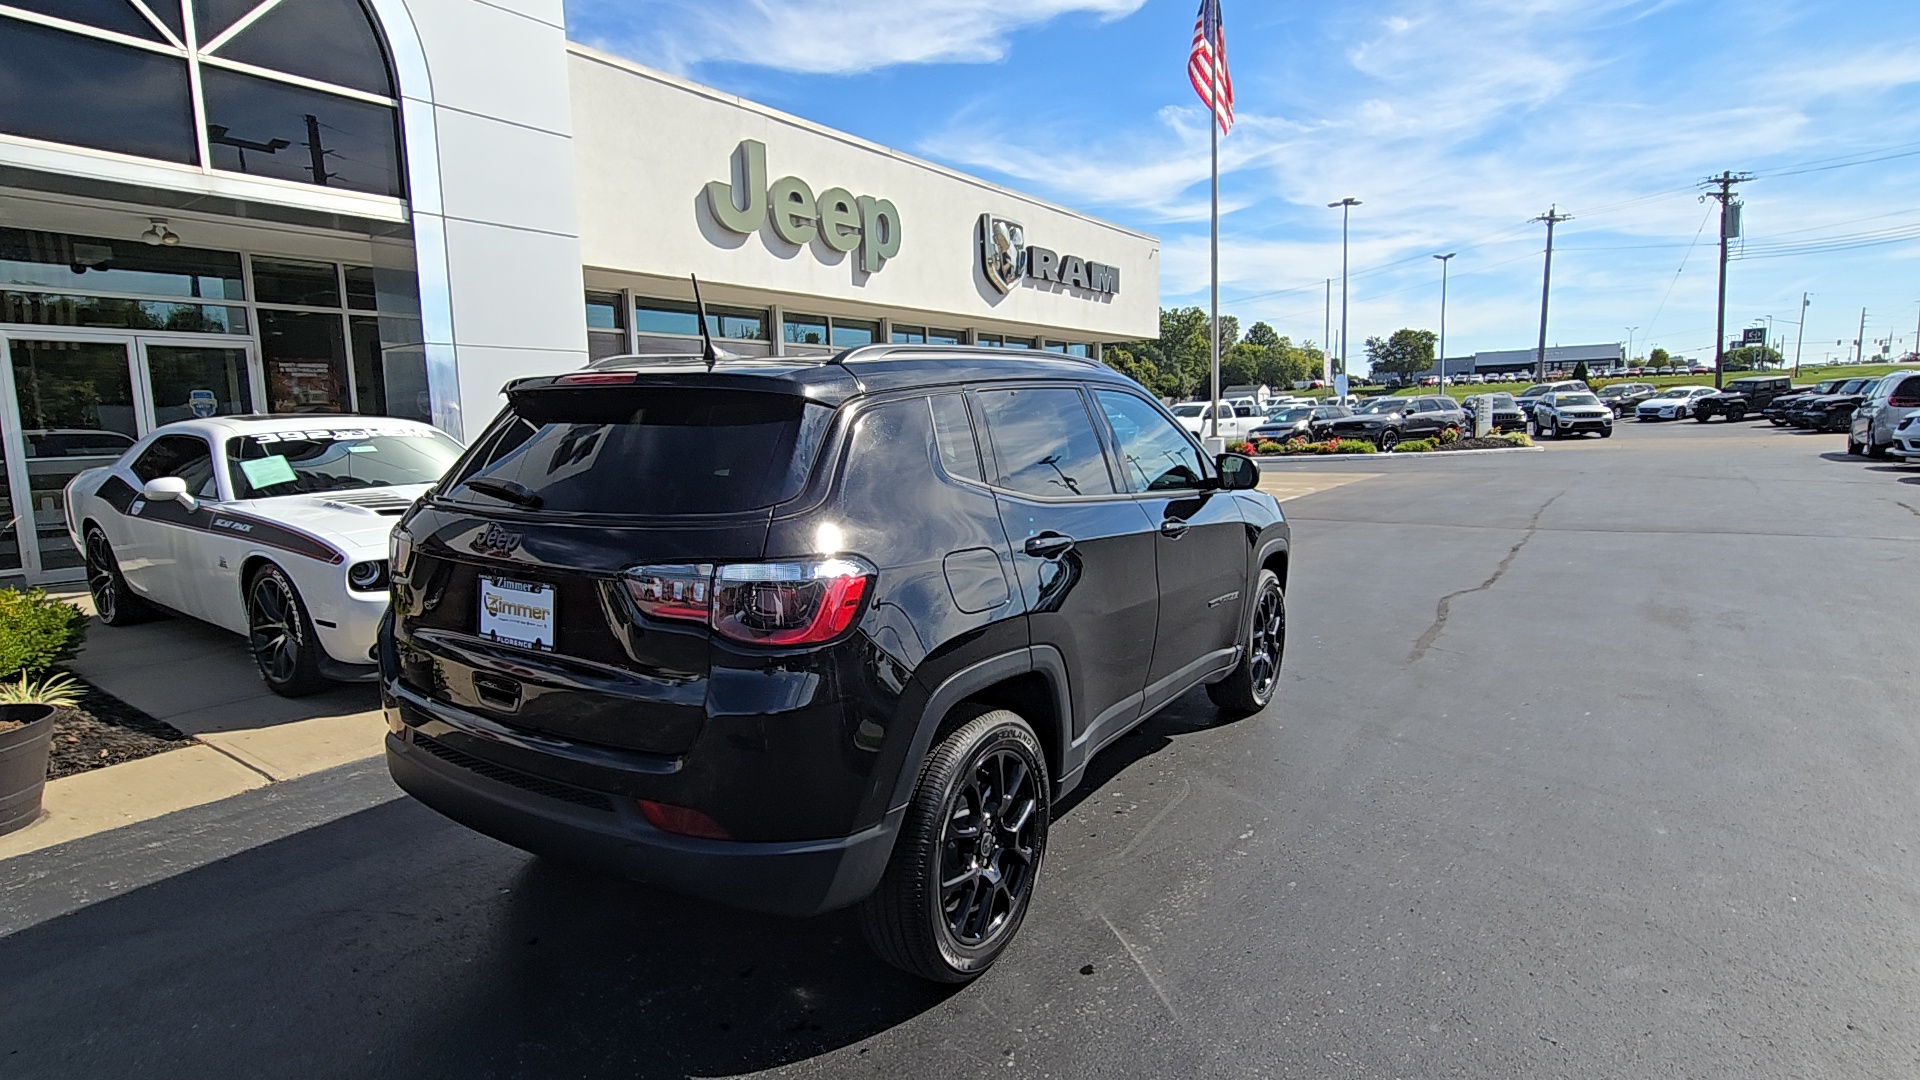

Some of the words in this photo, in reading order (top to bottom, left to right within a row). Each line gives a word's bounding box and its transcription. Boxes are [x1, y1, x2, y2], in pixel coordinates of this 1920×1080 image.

[704, 139, 901, 273] Jeep
[1025, 245, 1120, 295] RAM
[251, 430, 331, 444] 392
[476, 522, 522, 555] Jeep
[272, 569, 294, 600] SCAT
[496, 576, 533, 592] Zimmer
[486, 594, 550, 621] Zimmer
[496, 636, 532, 649] FLORENCE
